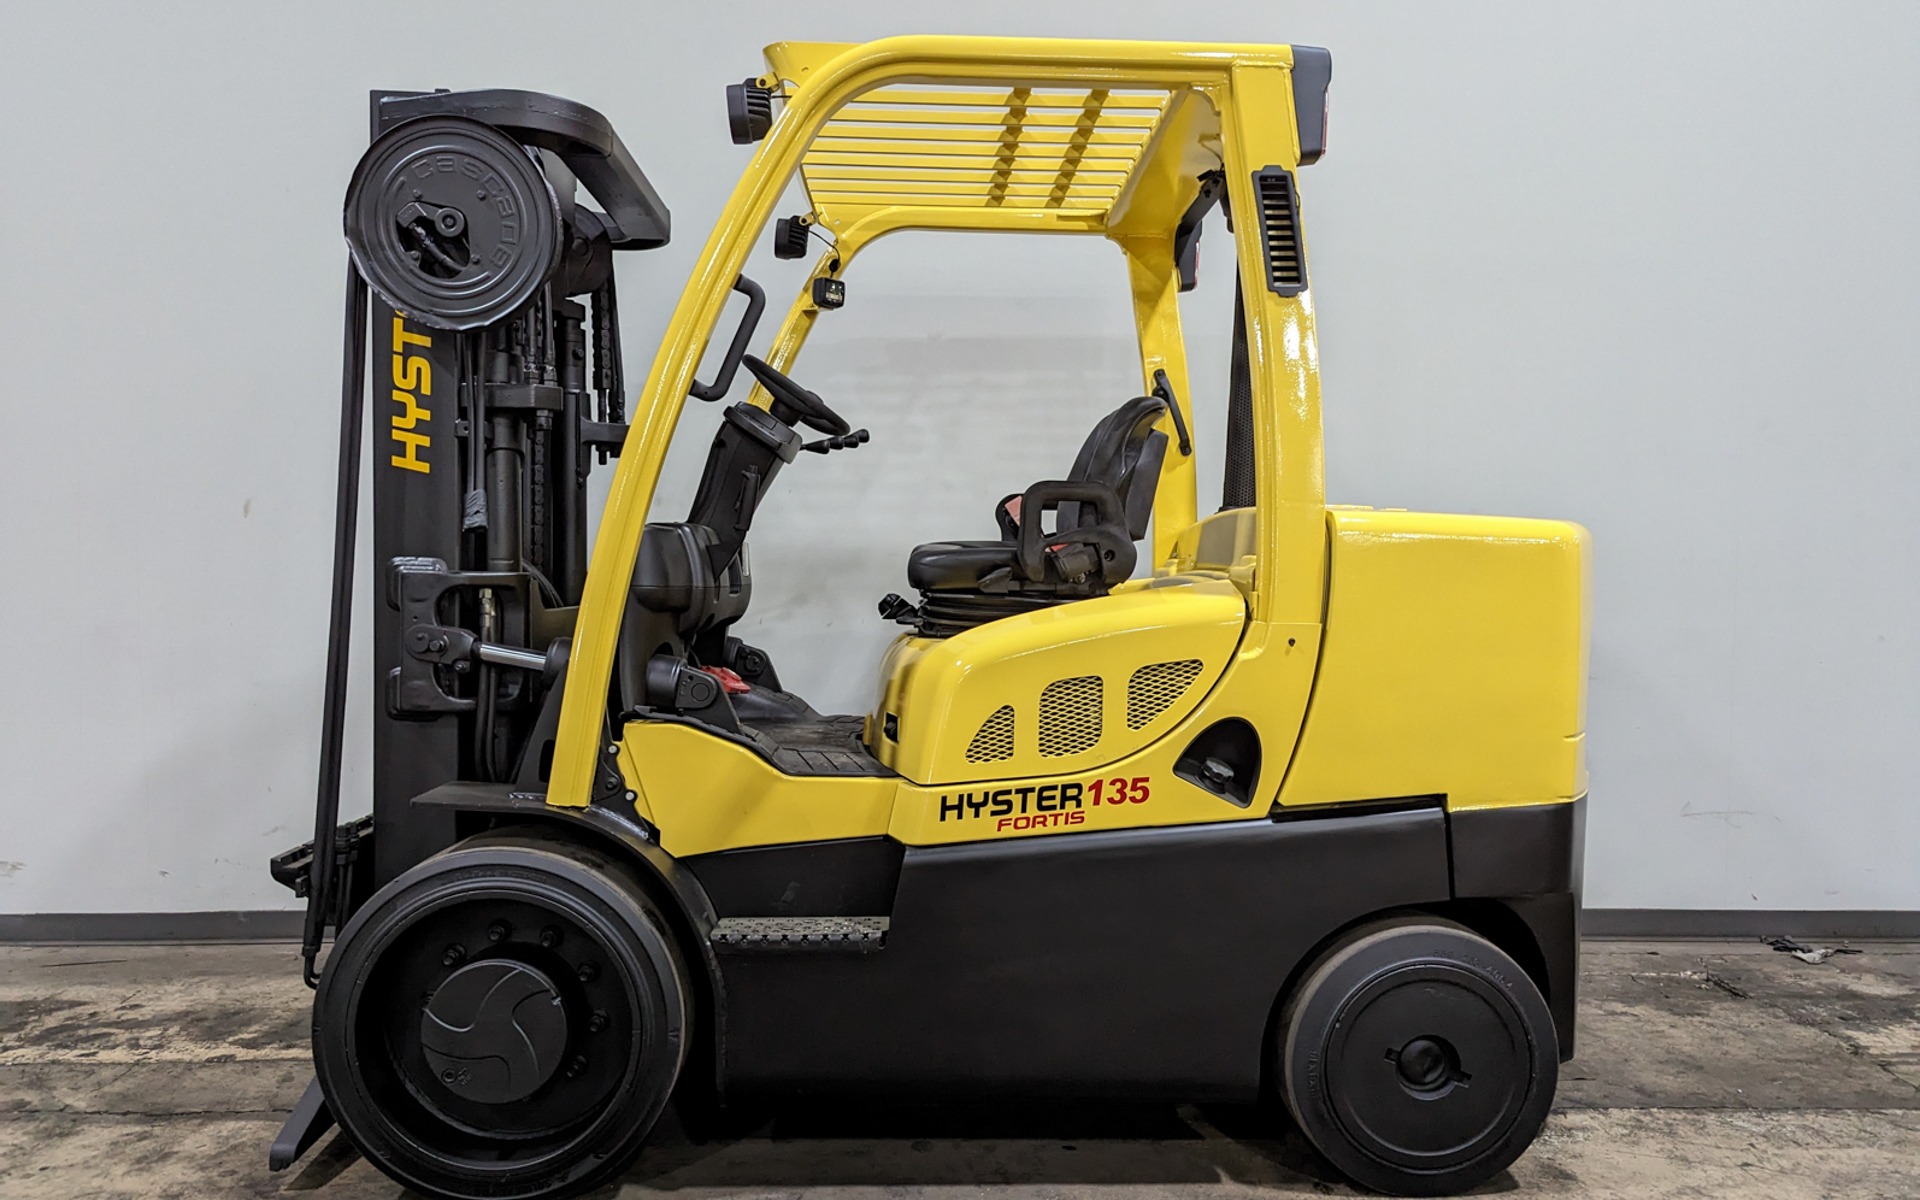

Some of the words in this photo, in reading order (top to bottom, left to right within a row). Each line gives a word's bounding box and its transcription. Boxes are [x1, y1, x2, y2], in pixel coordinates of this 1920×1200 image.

[391, 310, 432, 474] HYST
[940, 782, 1083, 822] HYSTER
[1087, 777, 1150, 807] 135
[997, 811, 1086, 832] FORTIS
